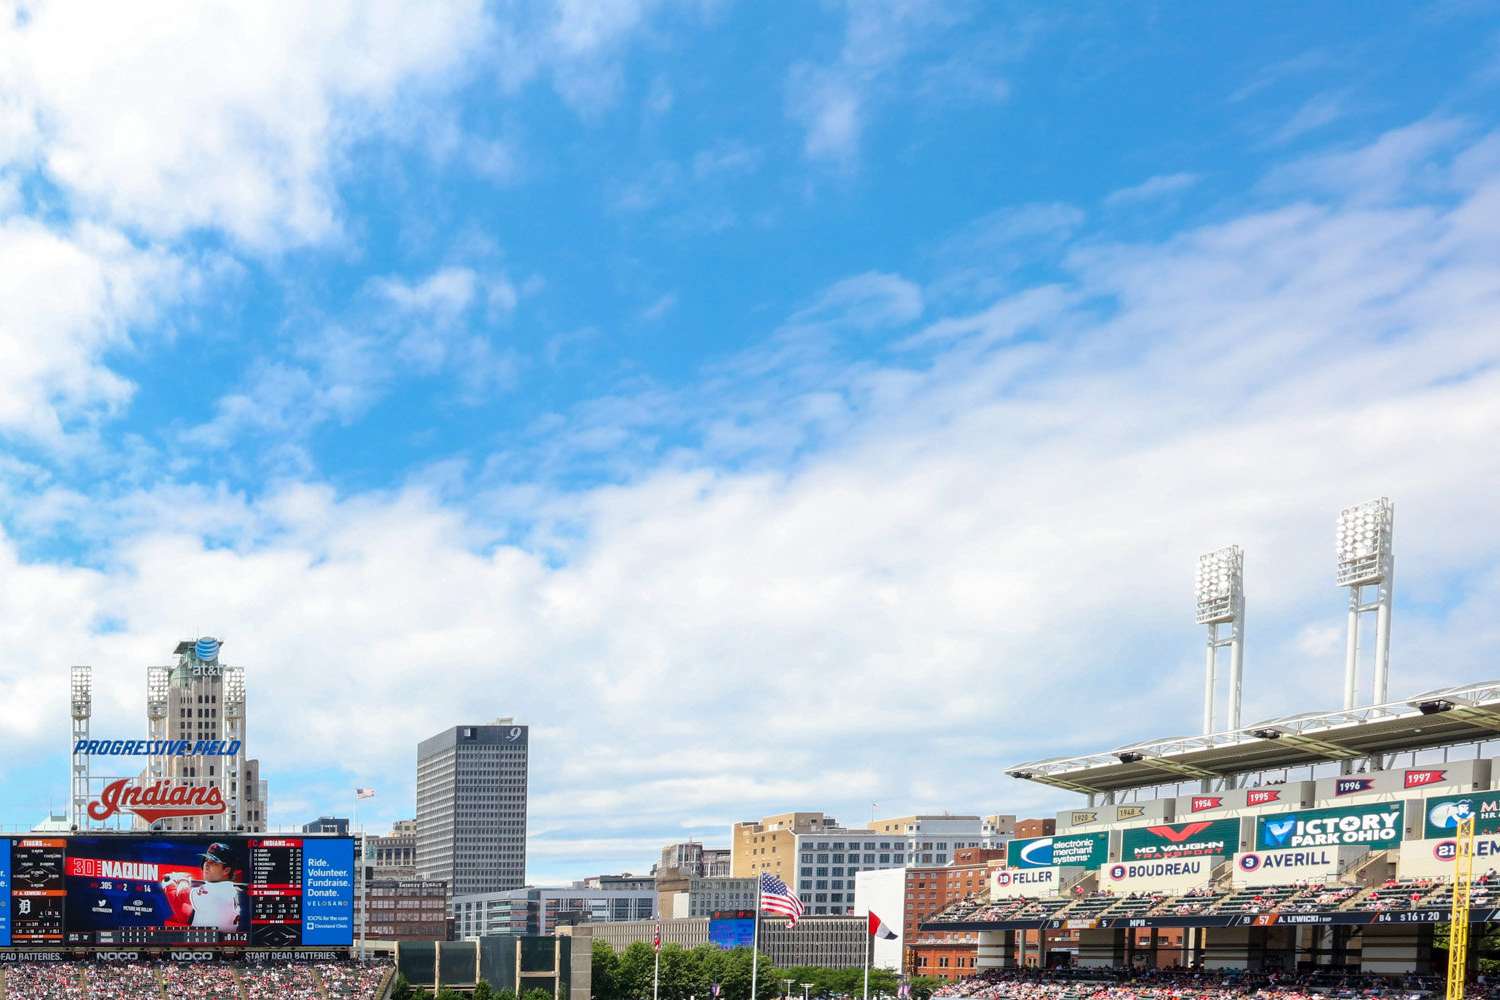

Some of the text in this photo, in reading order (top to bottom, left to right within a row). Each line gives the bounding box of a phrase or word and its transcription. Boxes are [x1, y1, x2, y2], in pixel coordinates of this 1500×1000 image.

[193, 666, 222, 676] at&t
[74, 740, 242, 755] PROGRESSIVE FIELD
[1408, 772, 1431, 783] 1997
[1340, 781, 1360, 791] 1996
[87, 778, 226, 824] Indians
[1250, 792, 1269, 802] 1995
[1194, 799, 1212, 809] 1954
[1119, 808, 1135, 817] 1948
[1073, 814, 1089, 823] 1920
[1292, 829, 1396, 847] PARK OHIO
[1053, 839, 1094, 849] electronic
[1134, 841, 1224, 855] MO VAUGHN
[1053, 847, 1093, 856] merchant
[1135, 848, 1224, 859] TRANSPORT
[1438, 845, 1455, 856] 21
[308, 859, 329, 867] Ride.
[1245, 858, 1254, 867] 3
[1263, 851, 1330, 868] AVERILL
[73, 858, 94, 876] 30
[102, 860, 159, 881] NAQUIN
[1129, 861, 1200, 878] BOUDREAU
[308, 869, 348, 877] Volunteer.
[1013, 871, 1052, 884] FELLER
[99, 882, 151, 893] .305 14
[308, 879, 350, 887] Fundraise.
[308, 889, 339, 897] Donate.
[1260, 916, 1269, 925] 57
[1288, 915, 1318, 923] LEWICKI
[18, 951, 62, 961] BATTERIES.
[96, 952, 138, 961] NOCO
[171, 951, 213, 961] NOCO
[245, 951, 338, 960] START DEAD BATTERIES.
